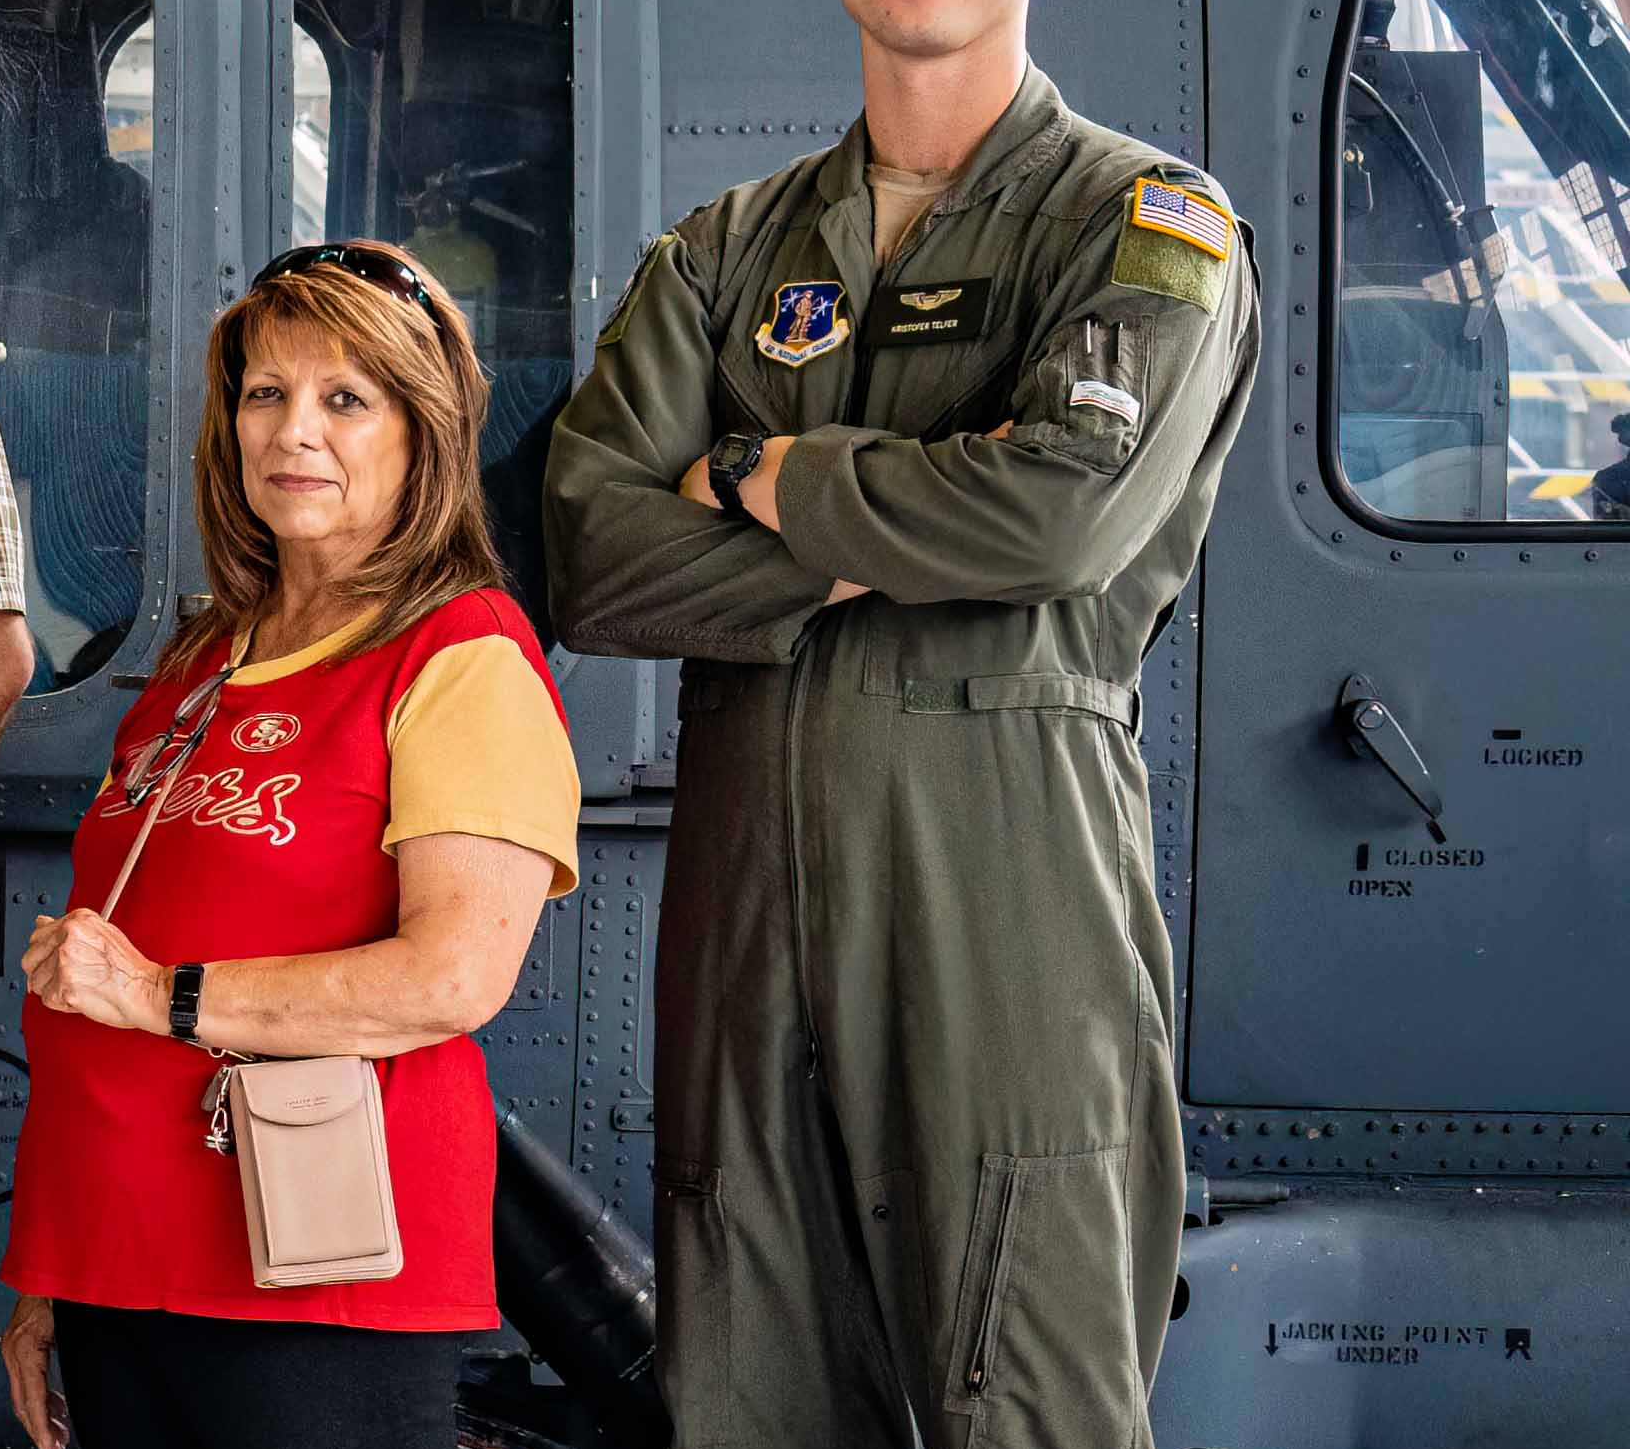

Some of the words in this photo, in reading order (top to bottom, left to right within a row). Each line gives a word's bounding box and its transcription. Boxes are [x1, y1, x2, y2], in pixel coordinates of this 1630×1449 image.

[1483, 747, 1584, 767] LOCKED
[1385, 848, 1486, 868] CLOSED
[1347, 879, 1414, 898] OPEN
[1281, 1322, 1386, 1342] JACKING
[1404, 1326, 1490, 1345] POINT
[1335, 1346, 1420, 1365] UNDER
